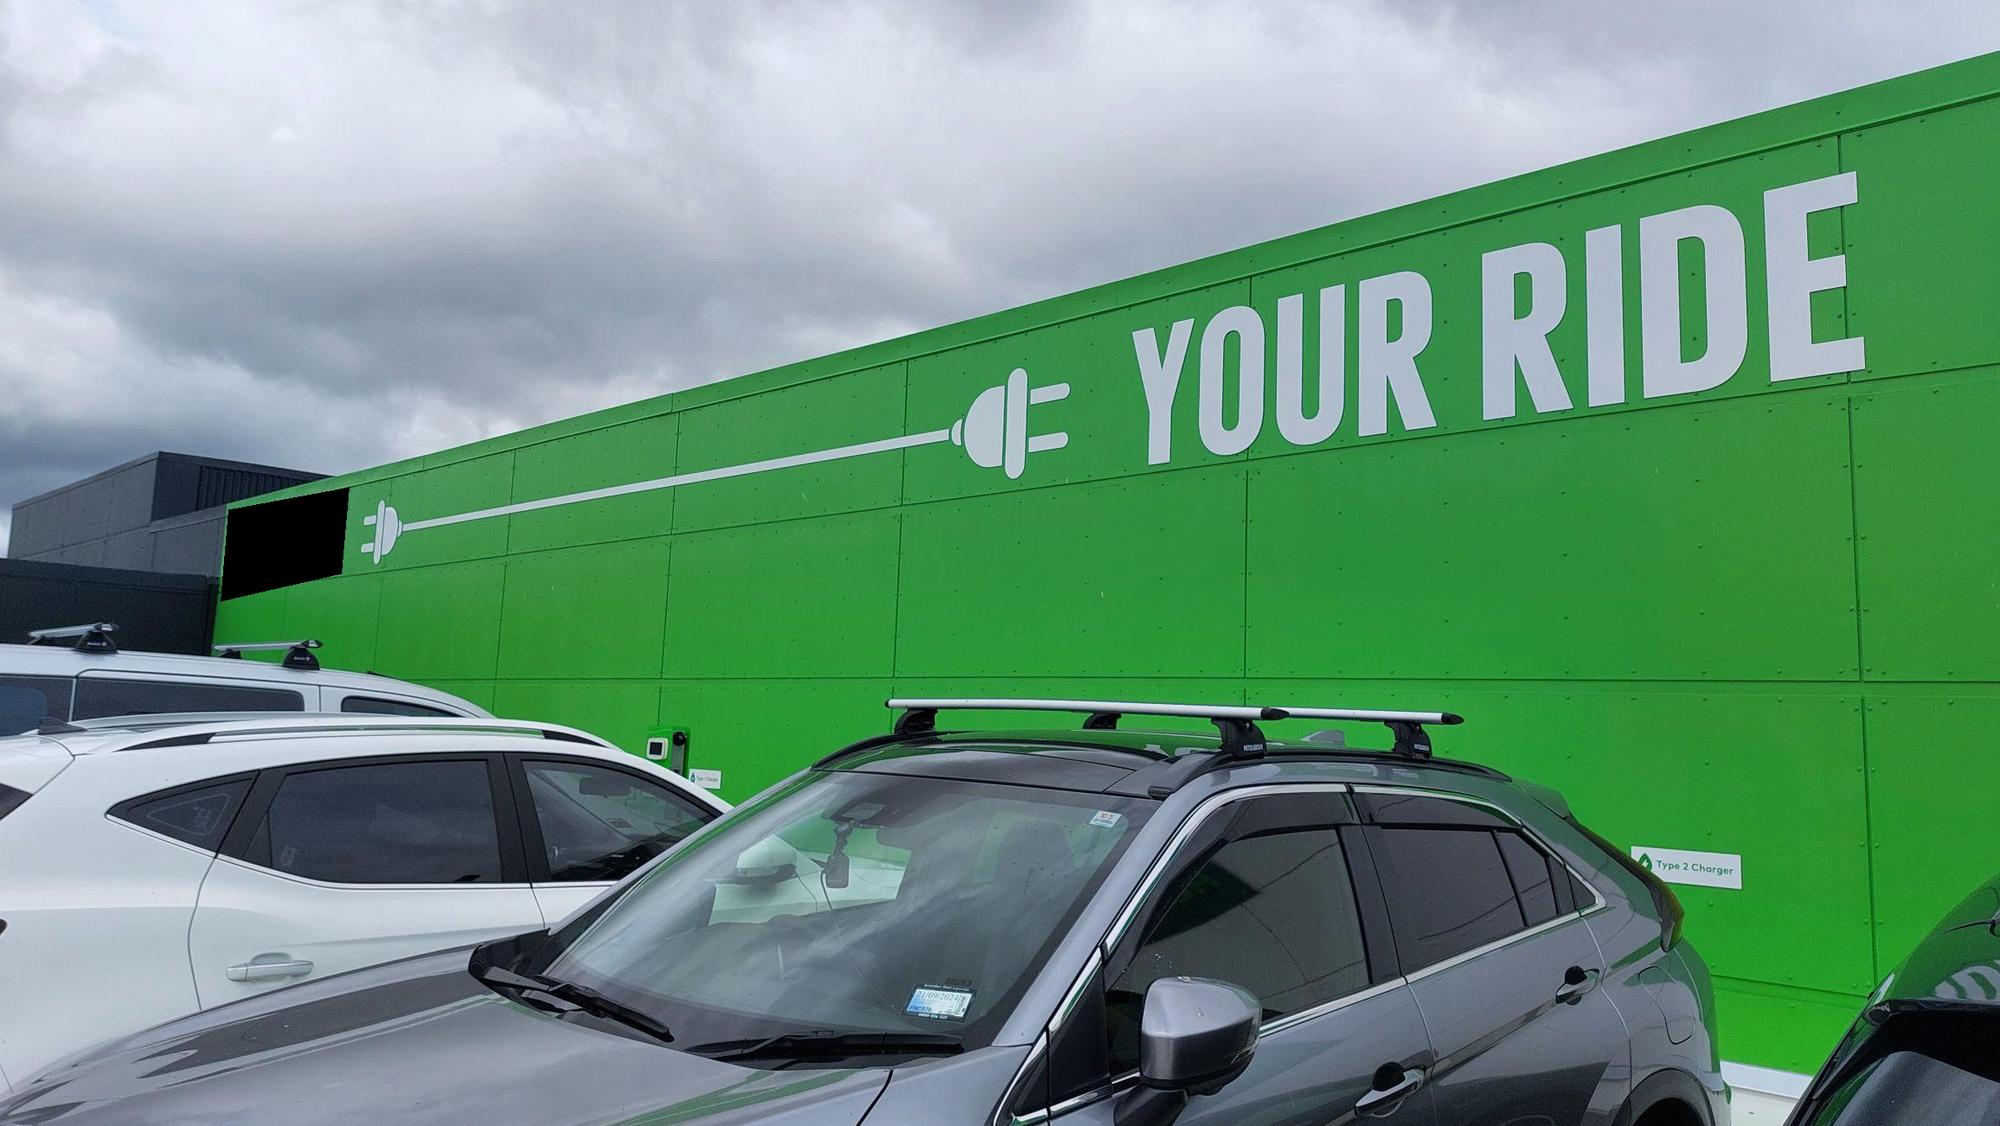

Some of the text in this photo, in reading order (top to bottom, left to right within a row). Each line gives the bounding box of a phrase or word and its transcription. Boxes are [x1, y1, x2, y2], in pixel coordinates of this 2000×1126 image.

[1132, 171, 1867, 466] YOUR RIDE
[1656, 859, 1734, 876] Type 2 Charger
